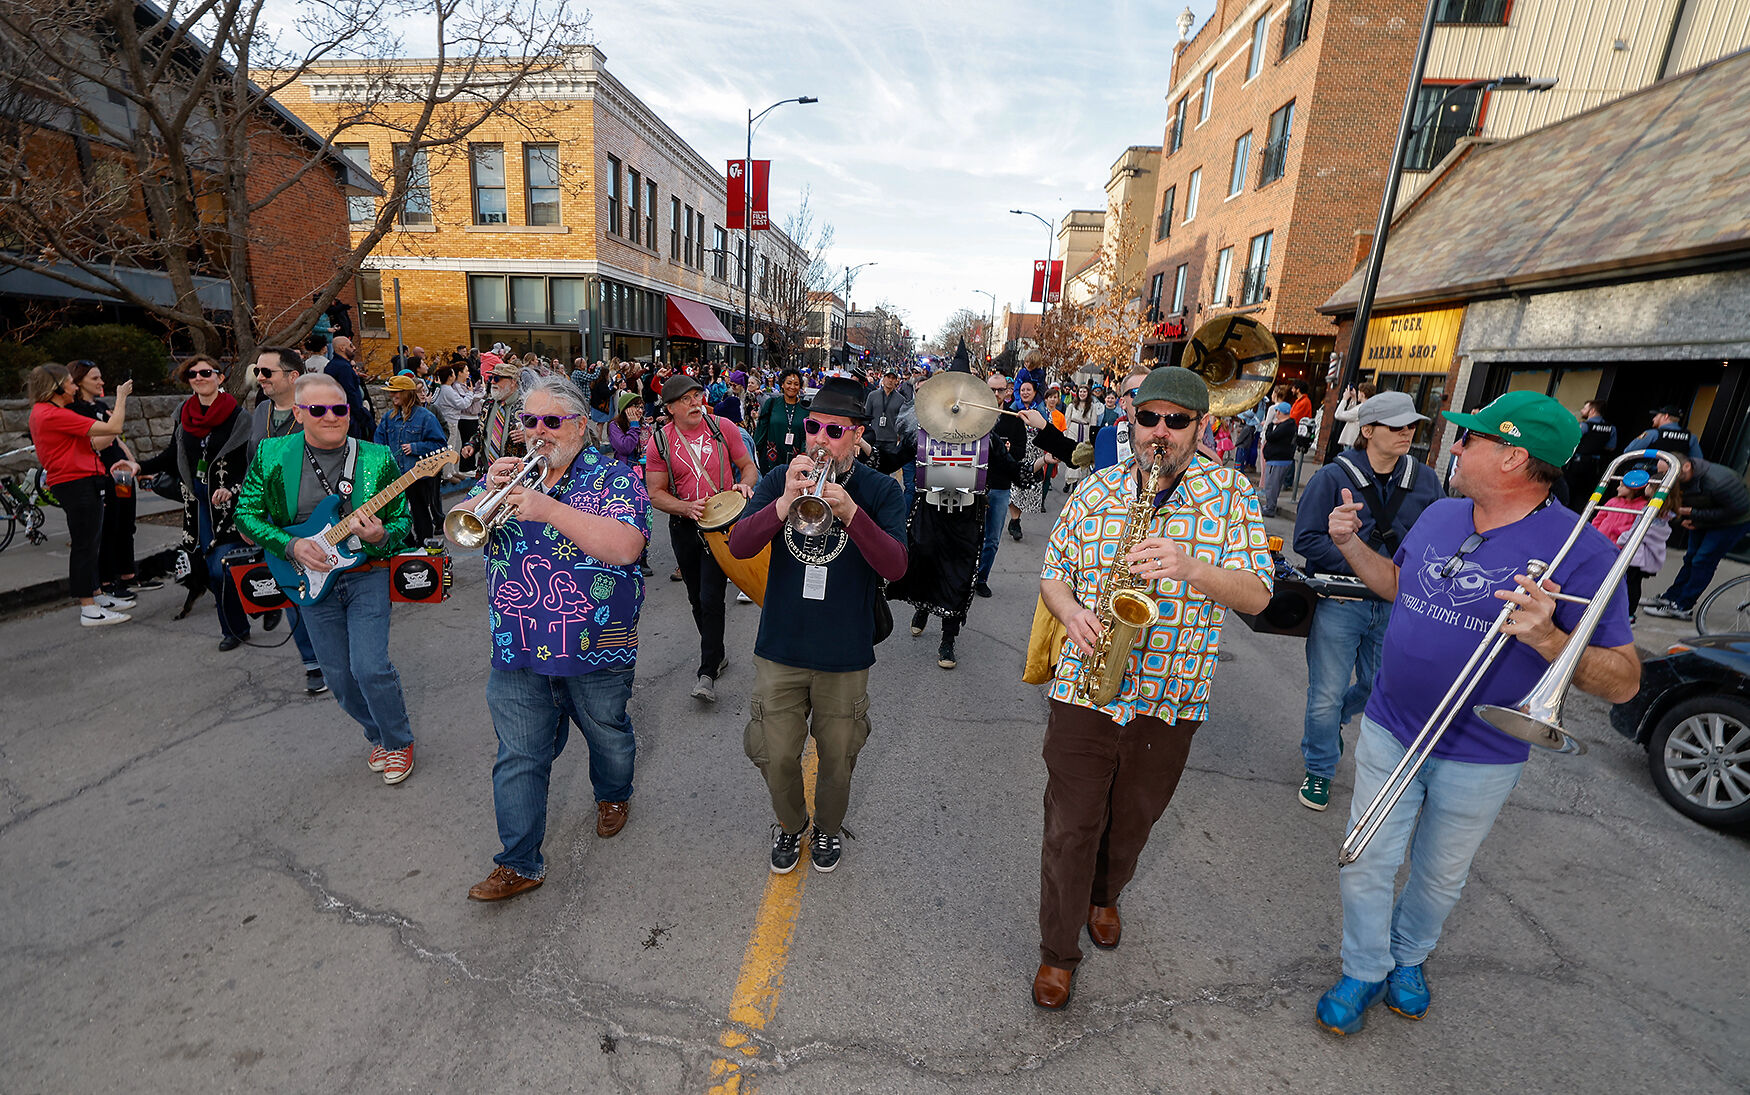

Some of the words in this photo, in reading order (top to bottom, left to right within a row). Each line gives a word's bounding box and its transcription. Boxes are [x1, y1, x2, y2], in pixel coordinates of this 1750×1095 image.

[1390, 317, 1422, 332] TIGER
[1368, 346, 1403, 360] BARBER
[1409, 345, 1437, 358] SHOP
[1592, 425, 1612, 433] POLICE
[1662, 431, 1690, 440] POLICE
[928, 439, 977, 456] MFU
[1426, 604, 1461, 626] FUNK
